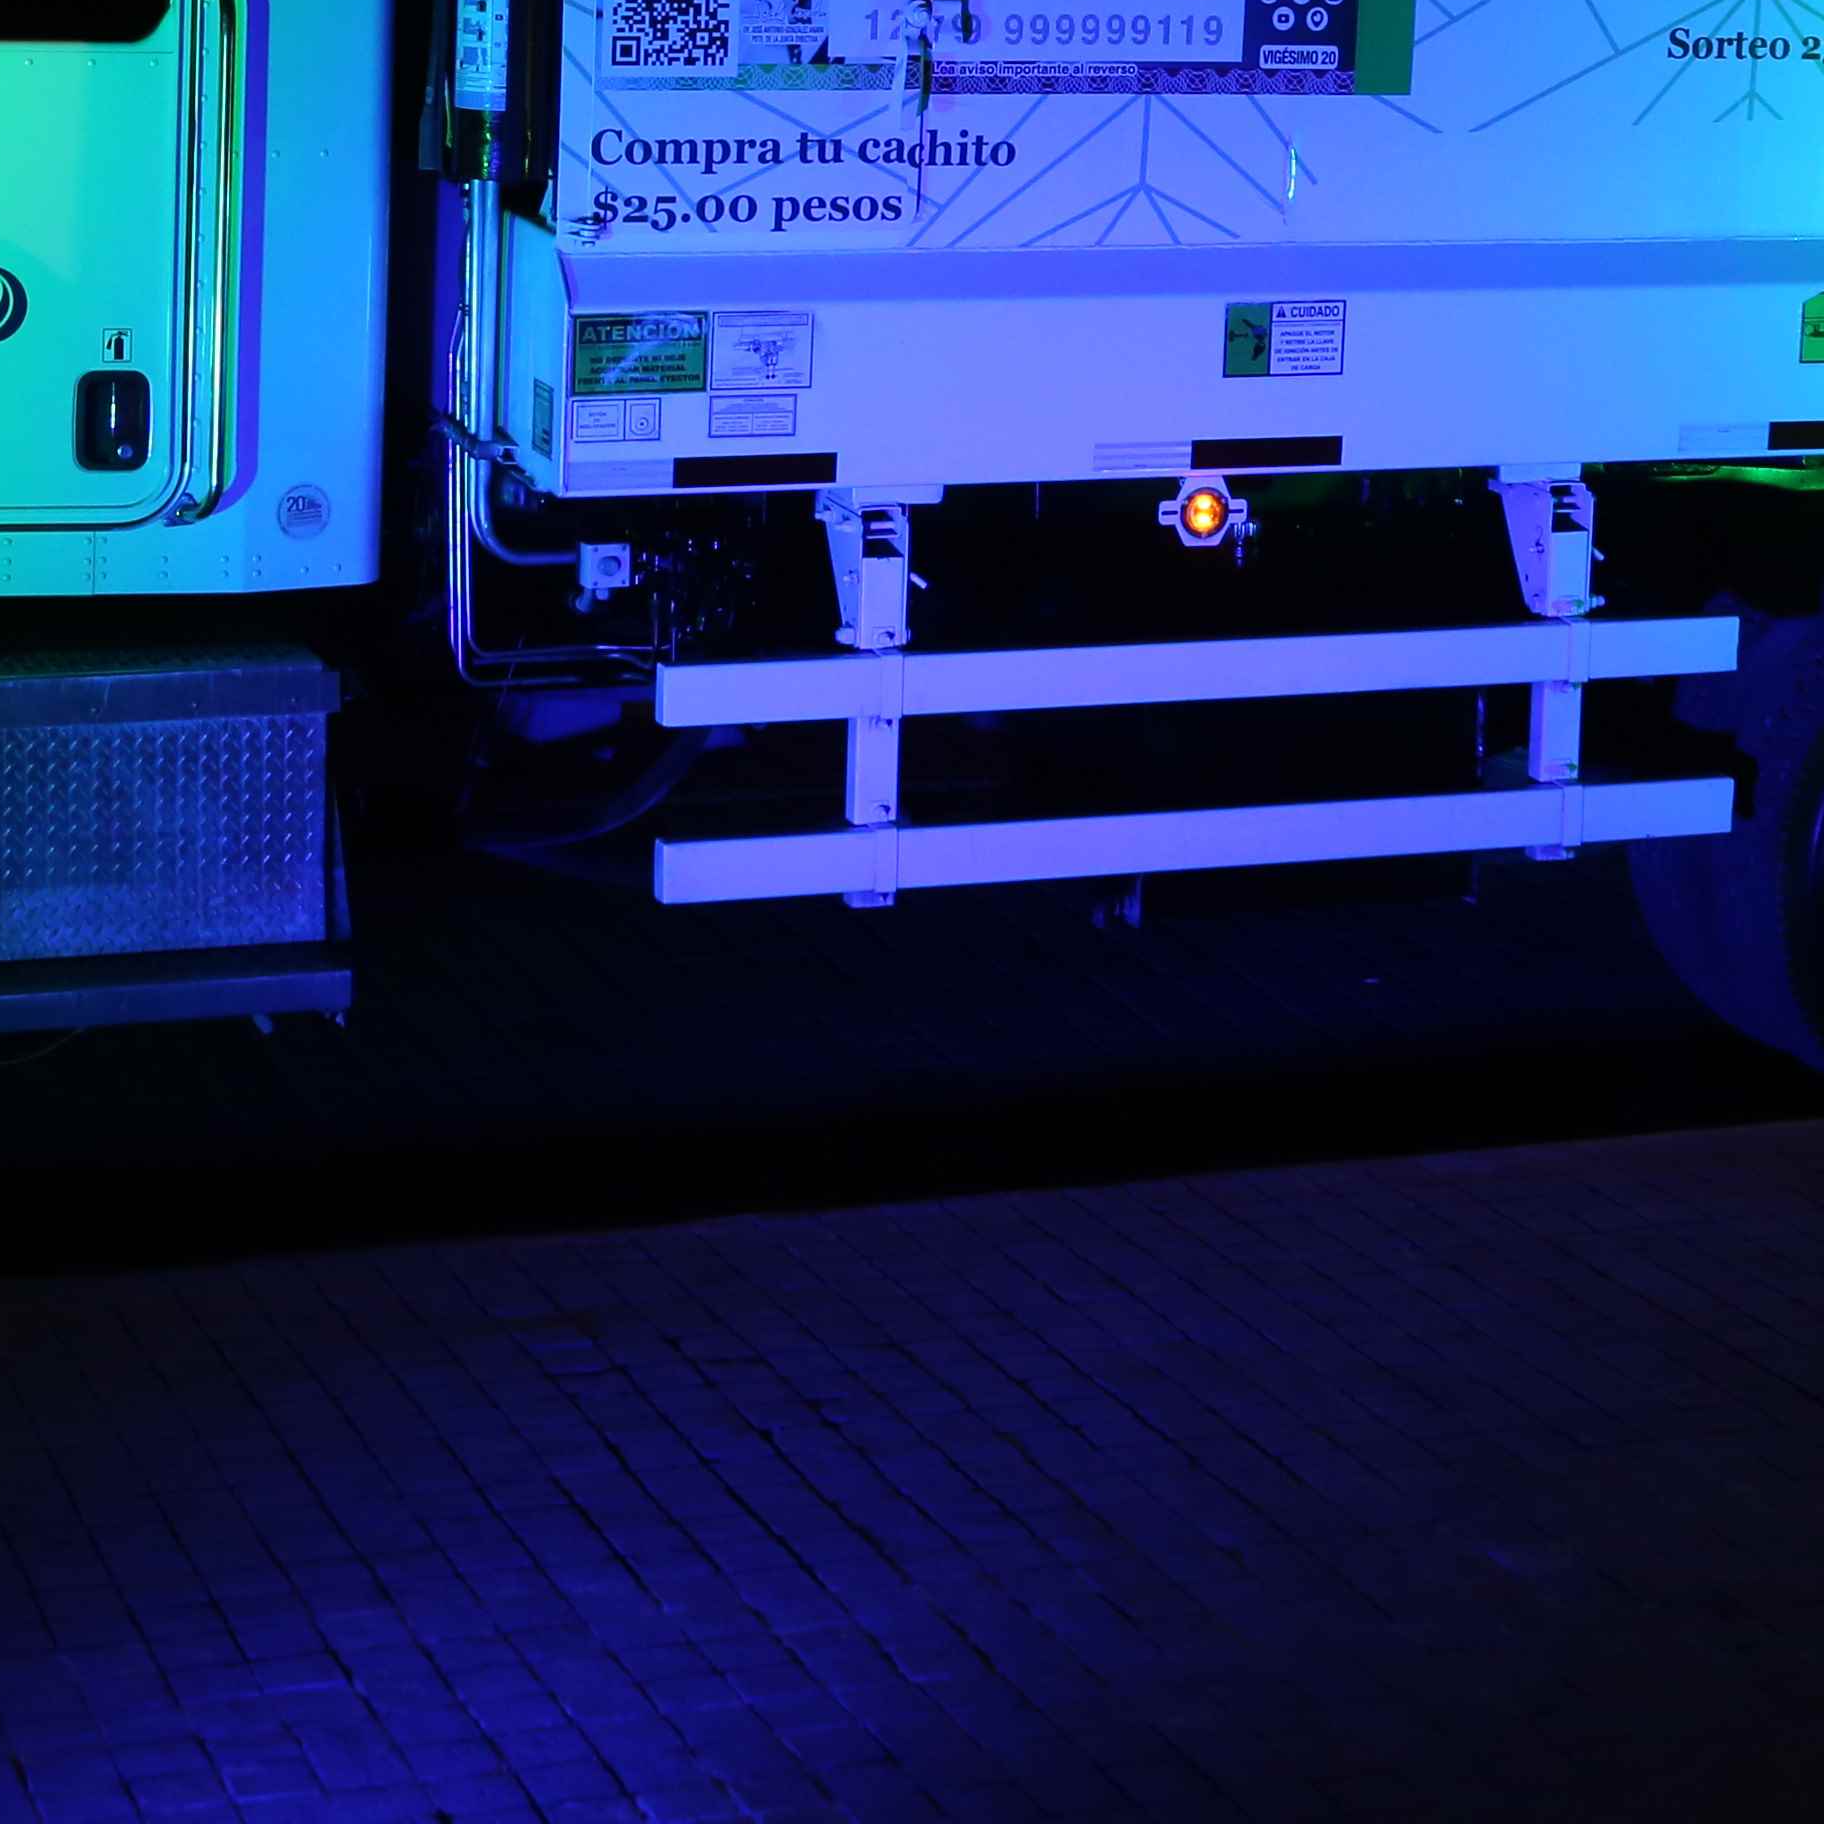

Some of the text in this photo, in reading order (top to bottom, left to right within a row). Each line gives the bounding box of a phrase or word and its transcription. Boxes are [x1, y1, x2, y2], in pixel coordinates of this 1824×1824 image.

[1004, 13, 1224, 47] 999999119
[1263, 46, 1337, 65] VIGÉSIMO 20
[1666, 28, 1790, 61] Sorteo
[933, 63, 1137, 77] Lea aviso importante al reverso
[591, 128, 1016, 174] Compra tu cachito
[593, 186, 903, 232] $25.00 pesos
[1291, 305, 1339, 318] CUIDADO
[287, 496, 305, 513] 20
